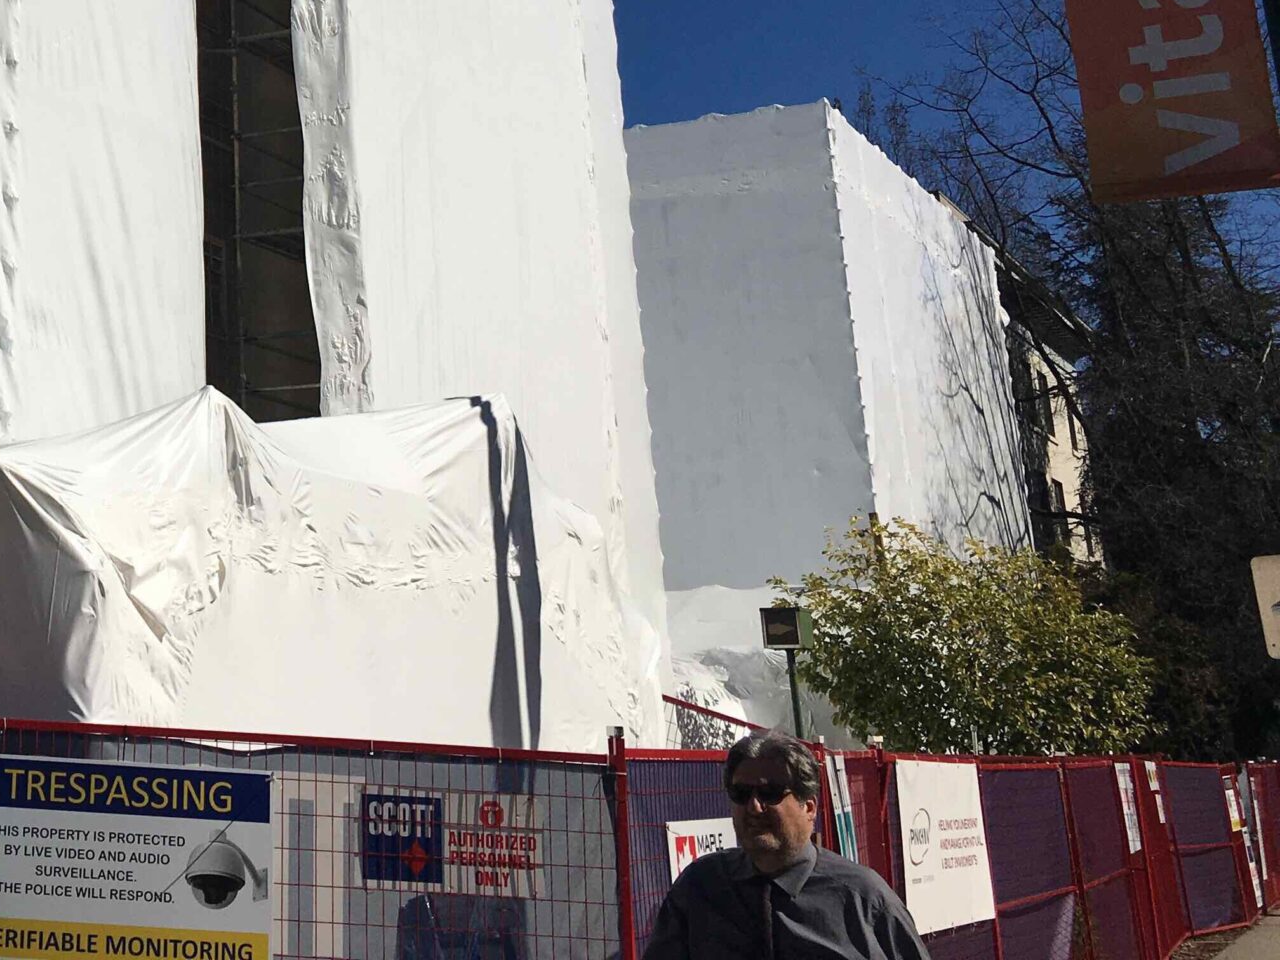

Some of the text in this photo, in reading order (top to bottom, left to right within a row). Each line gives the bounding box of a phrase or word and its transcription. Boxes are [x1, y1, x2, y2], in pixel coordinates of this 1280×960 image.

[4, 768, 232, 813] TRESPASSING
[368, 801, 434, 838] SCOTT
[22, 826, 90, 842] PROPERTY
[93, 831, 105, 842] IS
[109, 832, 186, 847] PROTECTED
[448, 831, 538, 851] AUTHORIZED
[697, 833, 724, 853] MAPLE
[4, 844, 170, 865] BY LIVE VIDEO AND AUDIO
[450, 851, 536, 870] PERSONNEL
[35, 865, 137, 882] SURVEILLANCE.
[475, 871, 510, 887] ONLY
[25, 884, 72, 897] POLICE
[75, 887, 106, 899] WILL
[109, 889, 175, 904] RESPOND.
[105, 935, 254, 960] MONITORING
